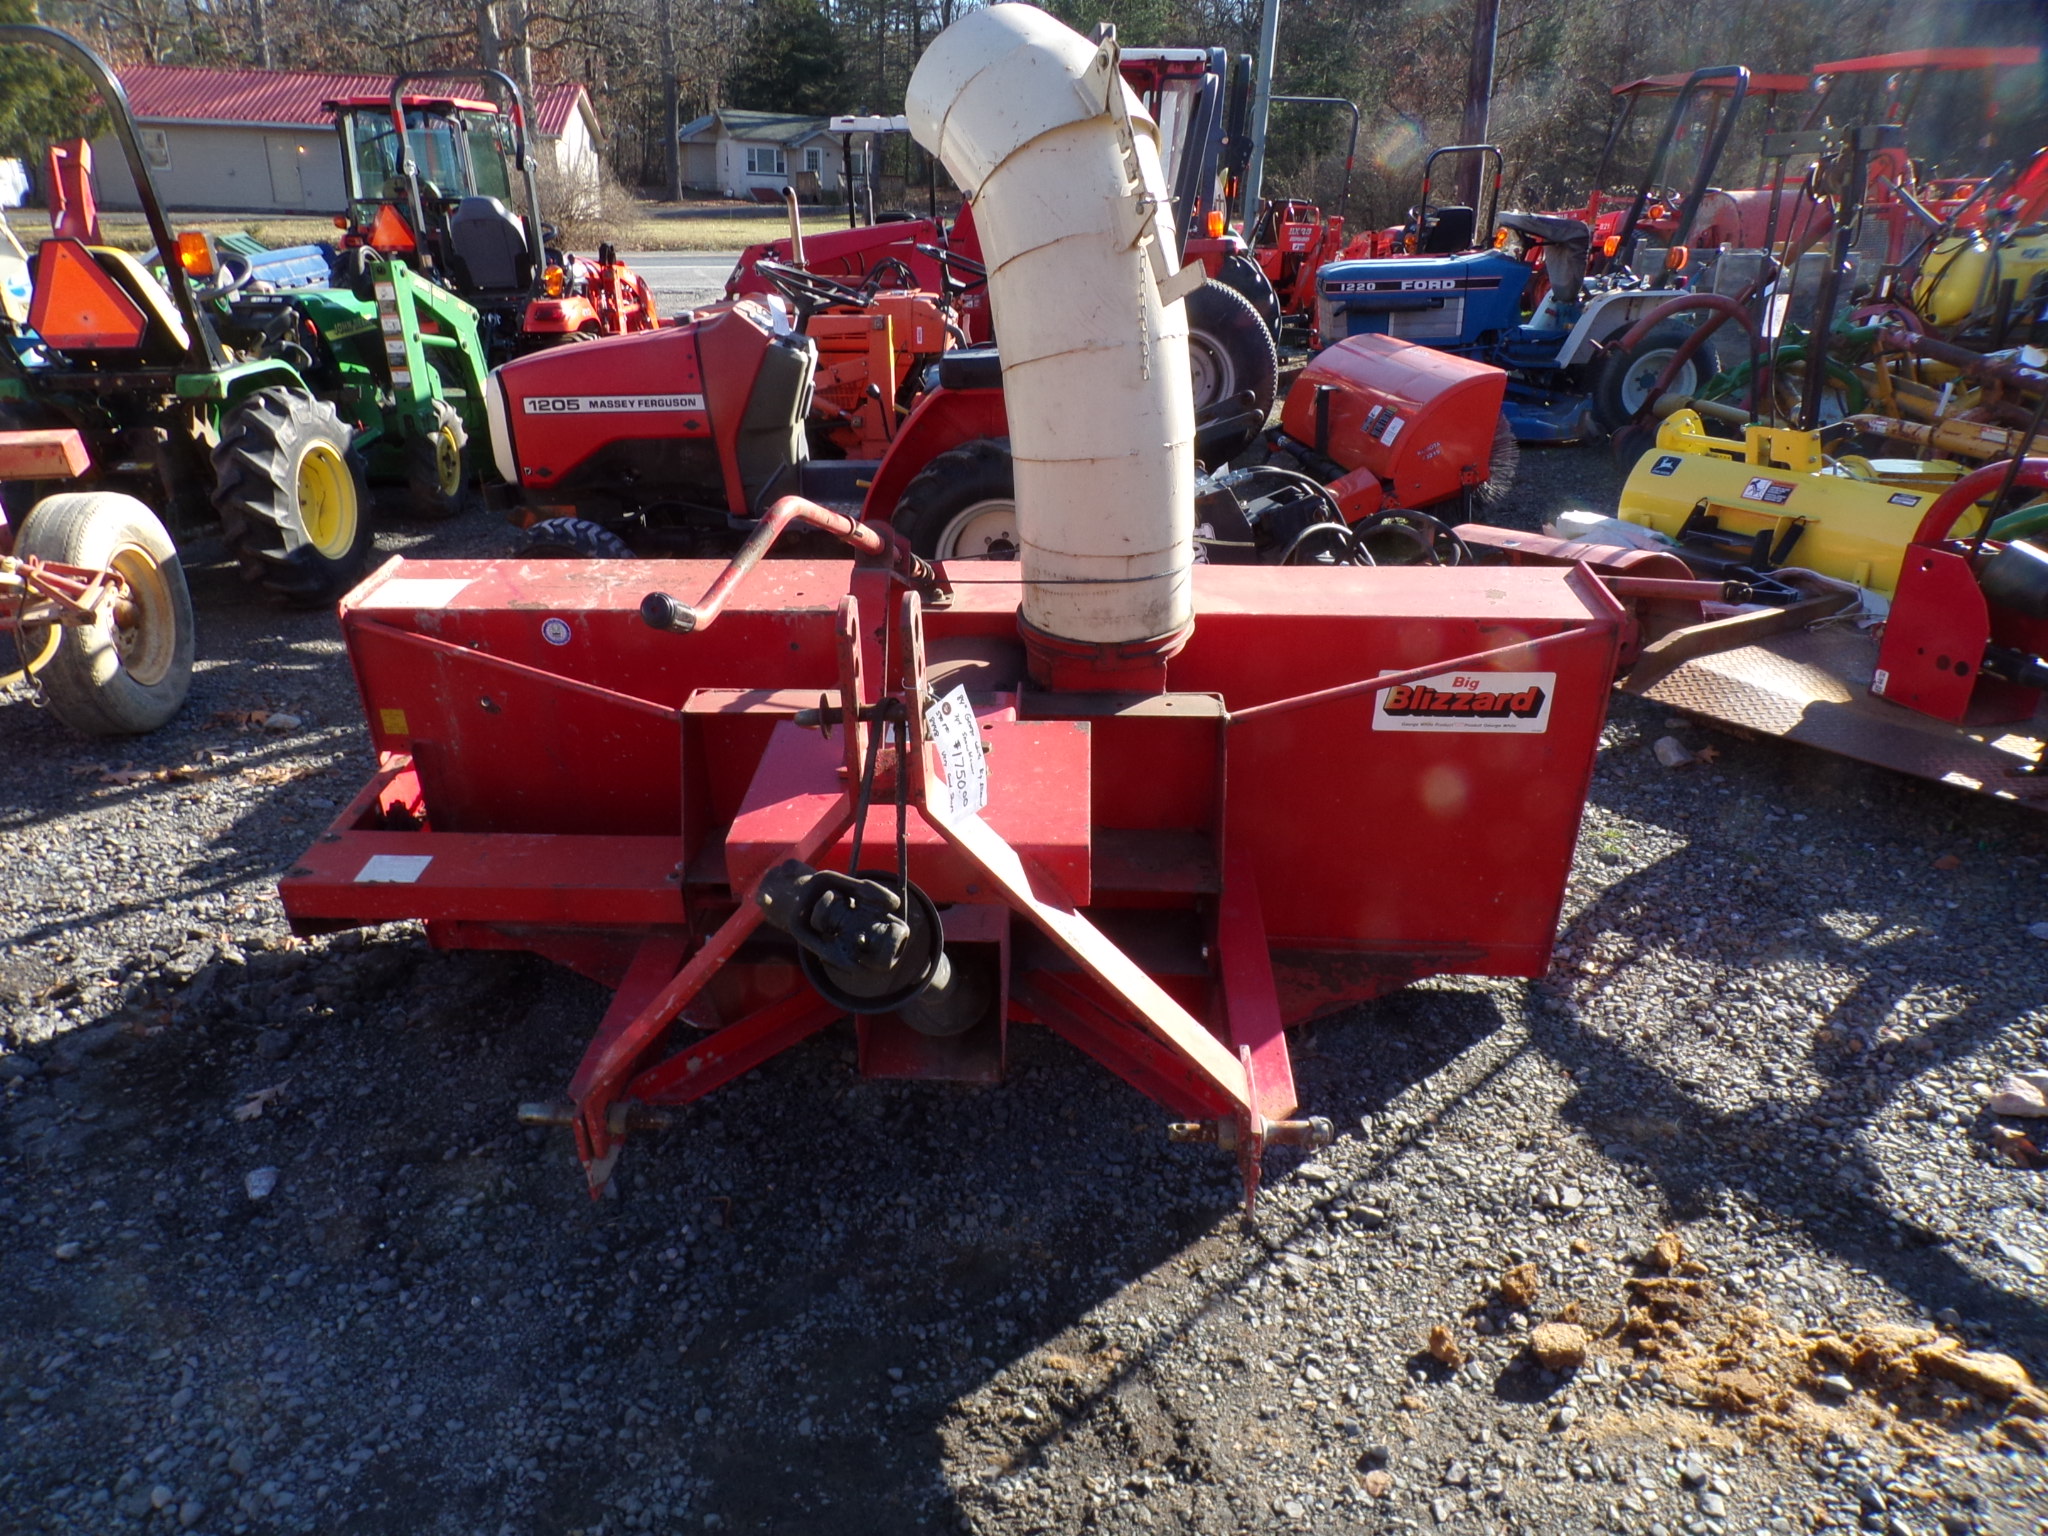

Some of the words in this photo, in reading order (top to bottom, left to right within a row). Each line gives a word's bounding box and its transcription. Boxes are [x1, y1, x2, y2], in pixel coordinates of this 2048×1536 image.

[1340, 282, 1376, 292] 1220
[1401, 279, 1456, 291] FORD
[528, 399, 580, 411] 1205
[589, 399, 635, 409] MASSEY
[638, 398, 697, 408] FERGUSON
[1452, 676, 1480, 691] Big
[1383, 685, 1546, 718] Blizzard
